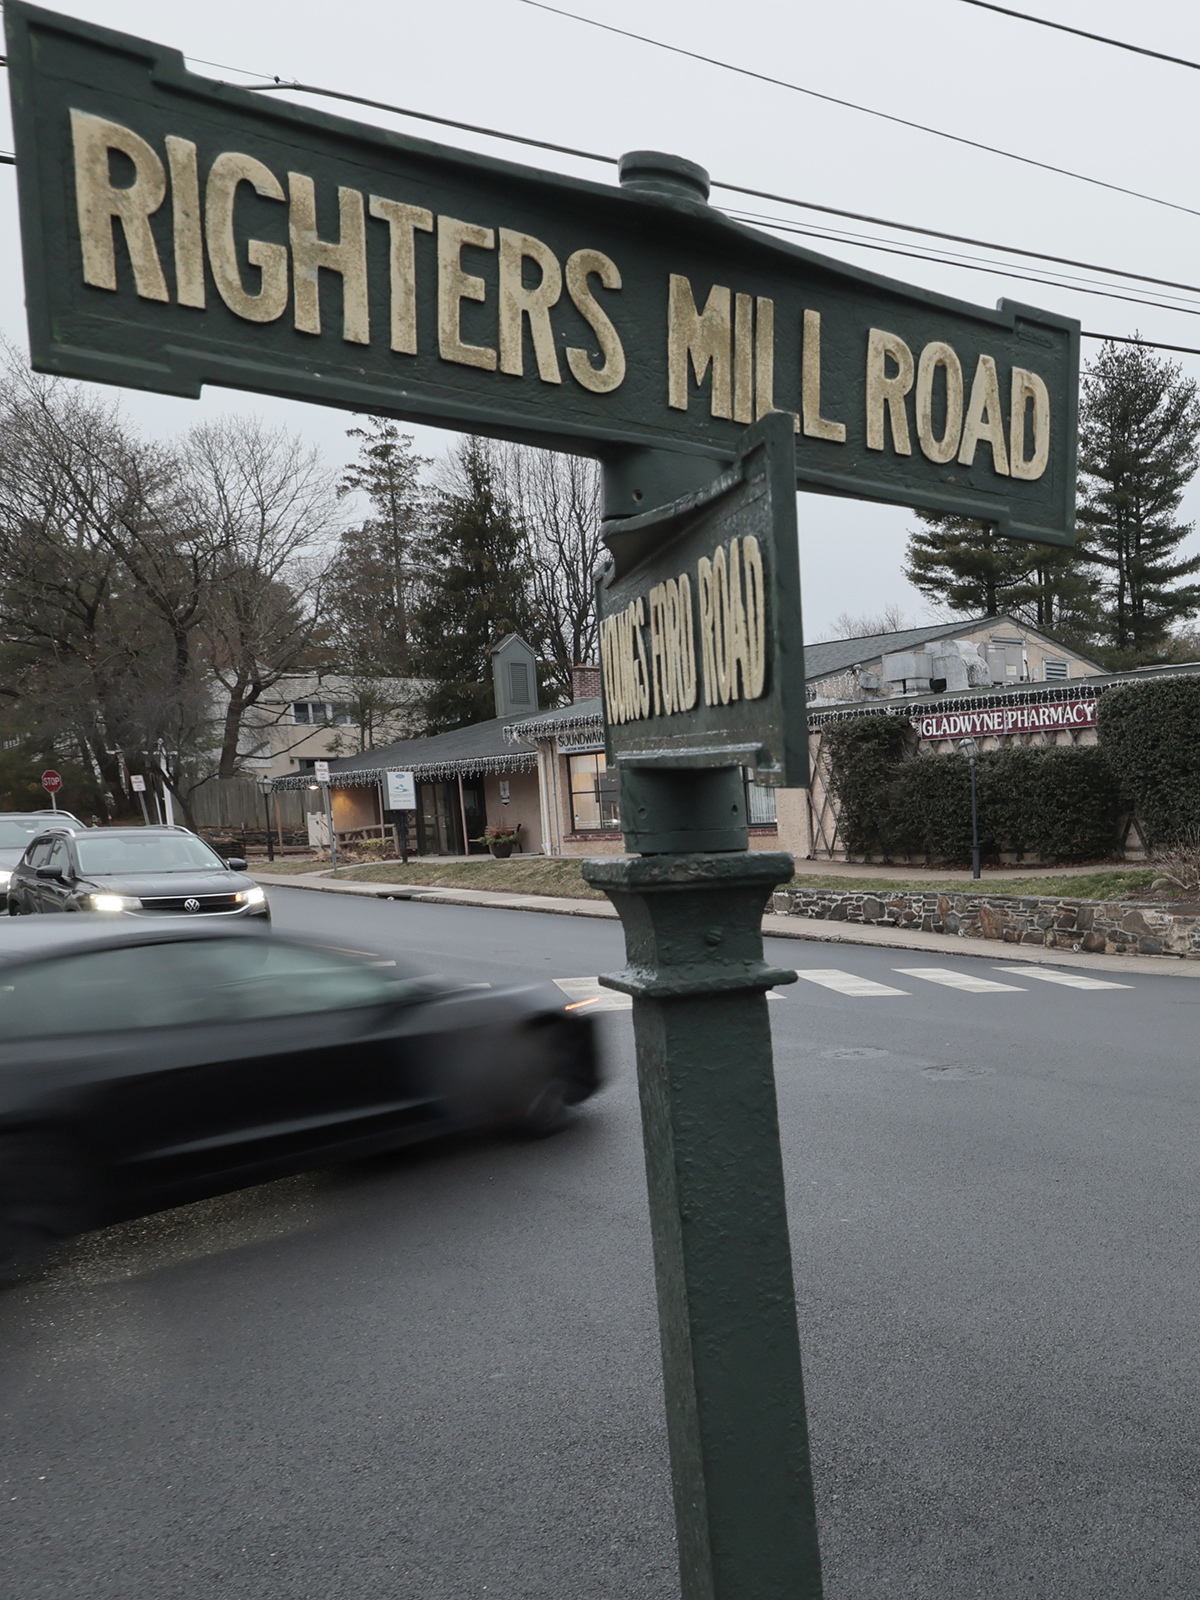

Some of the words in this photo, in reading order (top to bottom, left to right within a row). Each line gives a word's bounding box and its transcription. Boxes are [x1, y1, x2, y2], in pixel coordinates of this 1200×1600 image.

[69, 107, 626, 393] RIGHTERS
[667, 273, 846, 444] MILL
[866, 327, 1050, 481] ROAD
[600, 597, 650, 725] YOUNGS
[650, 573, 697, 716] FORD
[698, 535, 765, 706] ROAD
[922, 711, 1004, 736] GLADWYNE
[1007, 703, 1095, 729] PHARMACY
[43, 777, 60, 786] STOP
